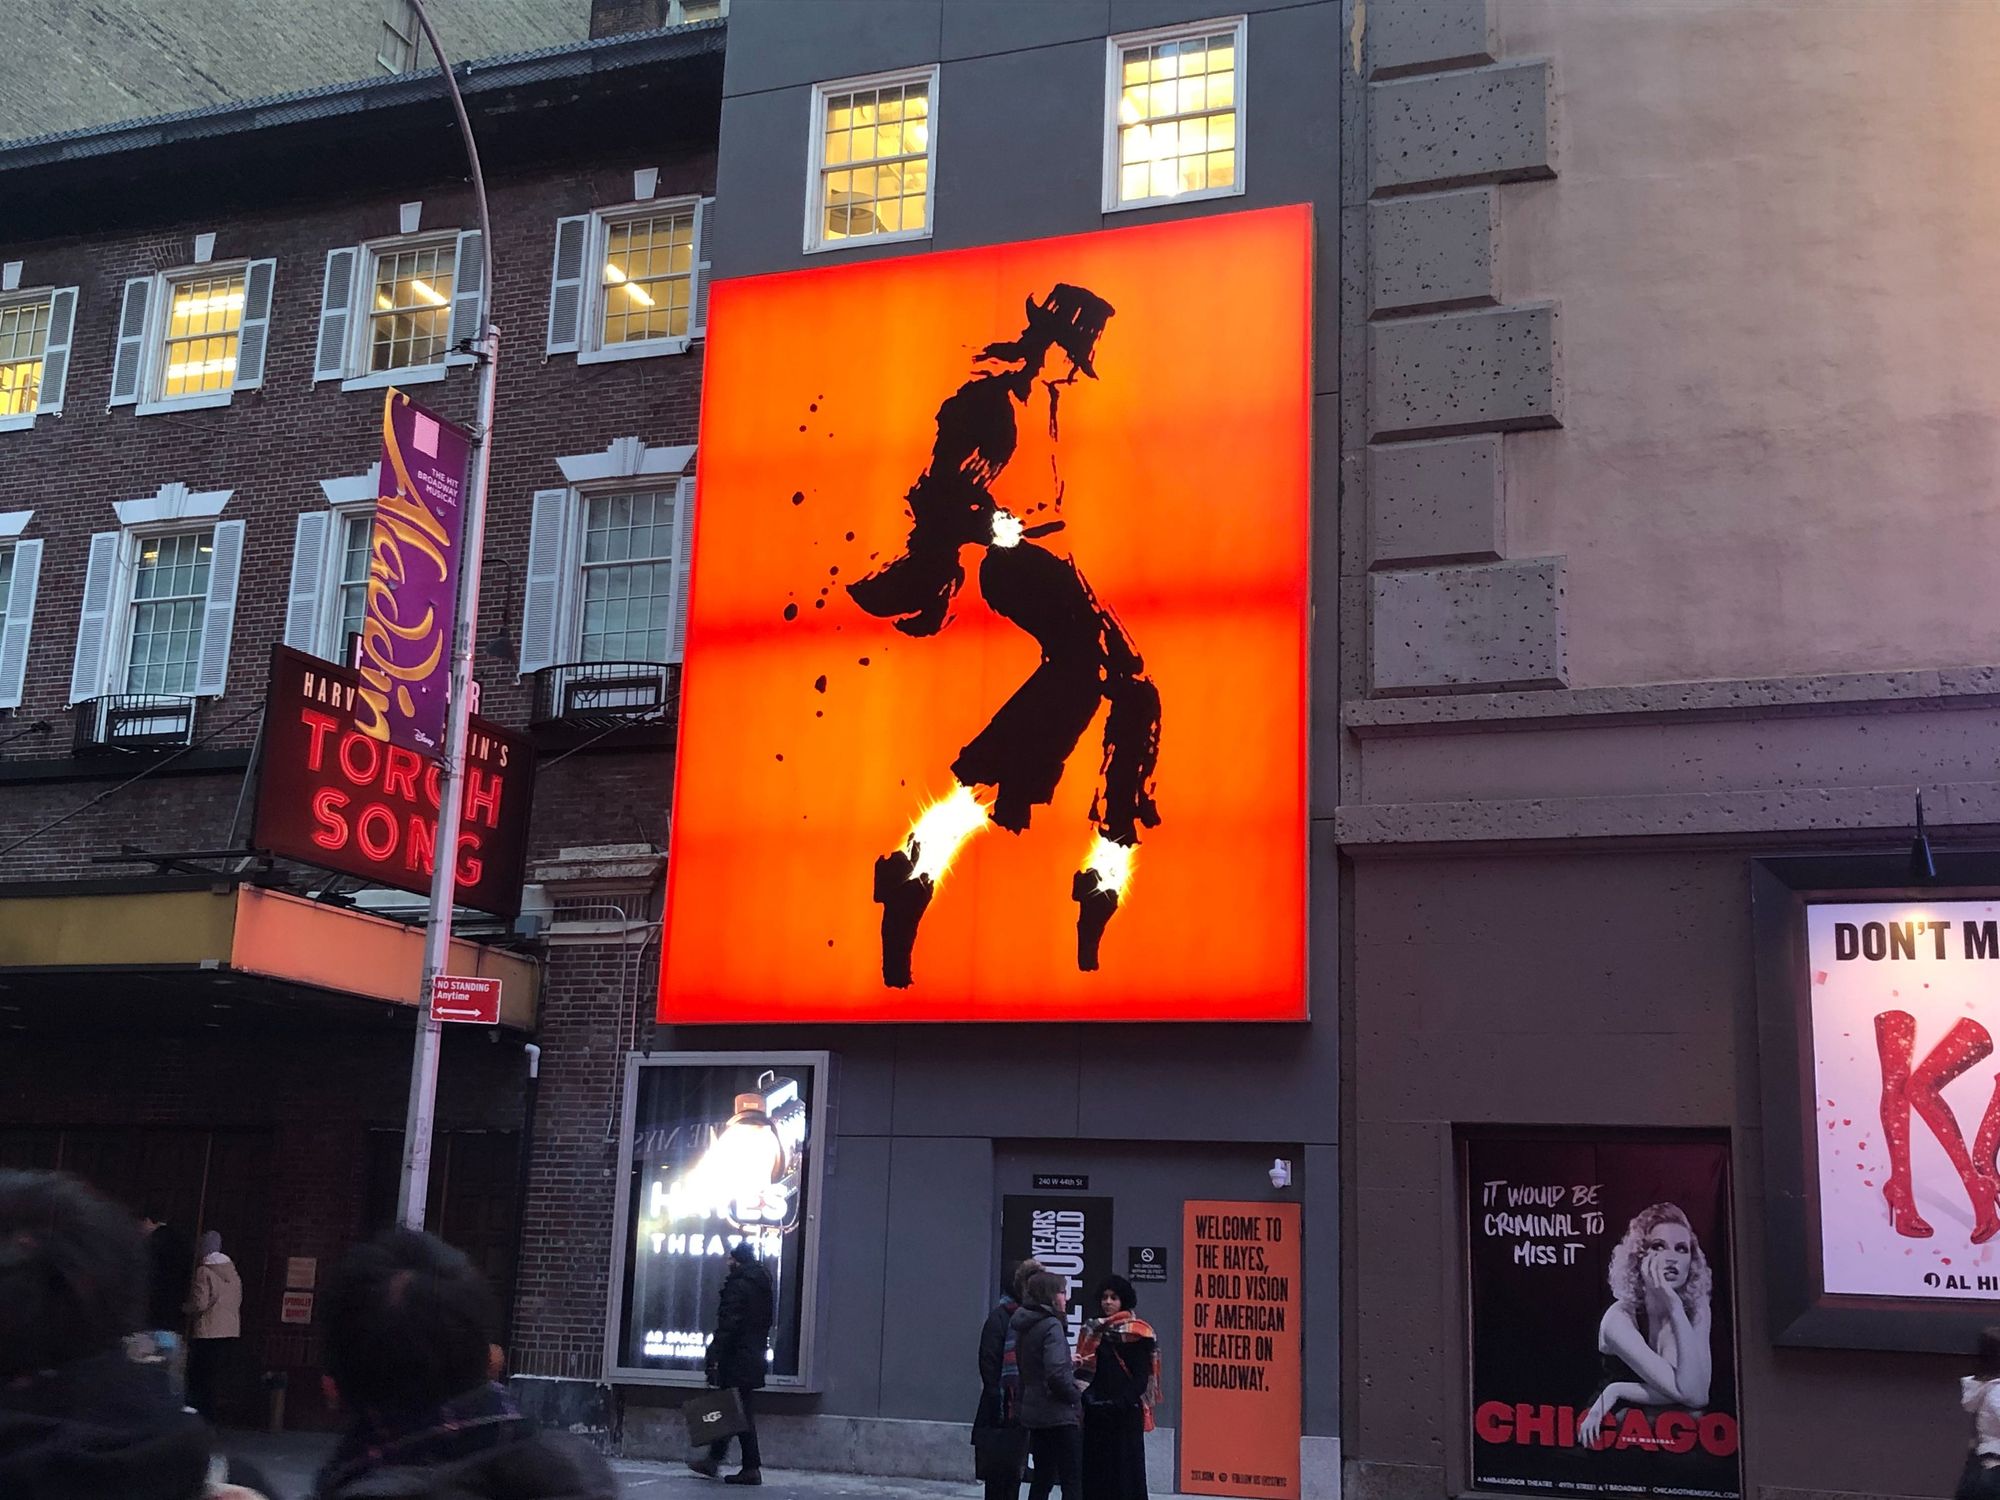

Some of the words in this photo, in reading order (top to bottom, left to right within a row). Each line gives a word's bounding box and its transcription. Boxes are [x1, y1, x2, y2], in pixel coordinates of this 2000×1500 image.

[417, 470, 458, 498] BROADWAY
[432, 468, 446, 482] THE
[446, 476, 459, 489] HIT
[425, 484, 457, 508] MUSICAL
[303, 672, 355, 711] HARV
[413, 728, 435, 748] Disney
[312, 787, 482, 886] SONG
[1835, 921, 1951, 961] DON'T
[437, 980, 449, 989] NO
[450, 981, 490, 993] STANDING
[437, 990, 470, 1001] Anytime
[1483, 1180, 1507, 1208] IT
[1507, 1184, 1566, 1208] WOULD
[1571, 1184, 1605, 1207] BE
[1032, 1210, 1056, 1255] YEARS
[1056, 1210, 1085, 1254] BOLD
[1196, 1215, 1261, 1241] WELCOME
[1265, 1217, 1282, 1242] TO
[1484, 1211, 1581, 1237] CRIMINAL
[1581, 1211, 1605, 1235] TO
[1195, 1244, 1219, 1269] THE
[1223, 1245, 1269, 1275] HAYES,
[1514, 1240, 1557, 1267] MISS
[1563, 1243, 1586, 1266] IT
[1195, 1273, 1203, 1298] A
[1207, 1274, 1241, 1300] BOLD
[1245, 1276, 1288, 1302] VISION
[1946, 1274, 1971, 1290] AL
[1194, 1303, 1210, 1329] OF
[1215, 1304, 1285, 1332] AMERICAN
[1194, 1332, 1251, 1360] THEATER
[1255, 1336, 1273, 1361] ON
[1193, 1362, 1269, 1392] BROADWAY.
[702, 1410, 723, 1423] UGG
[1475, 1401, 1738, 1457] CHICAGO
